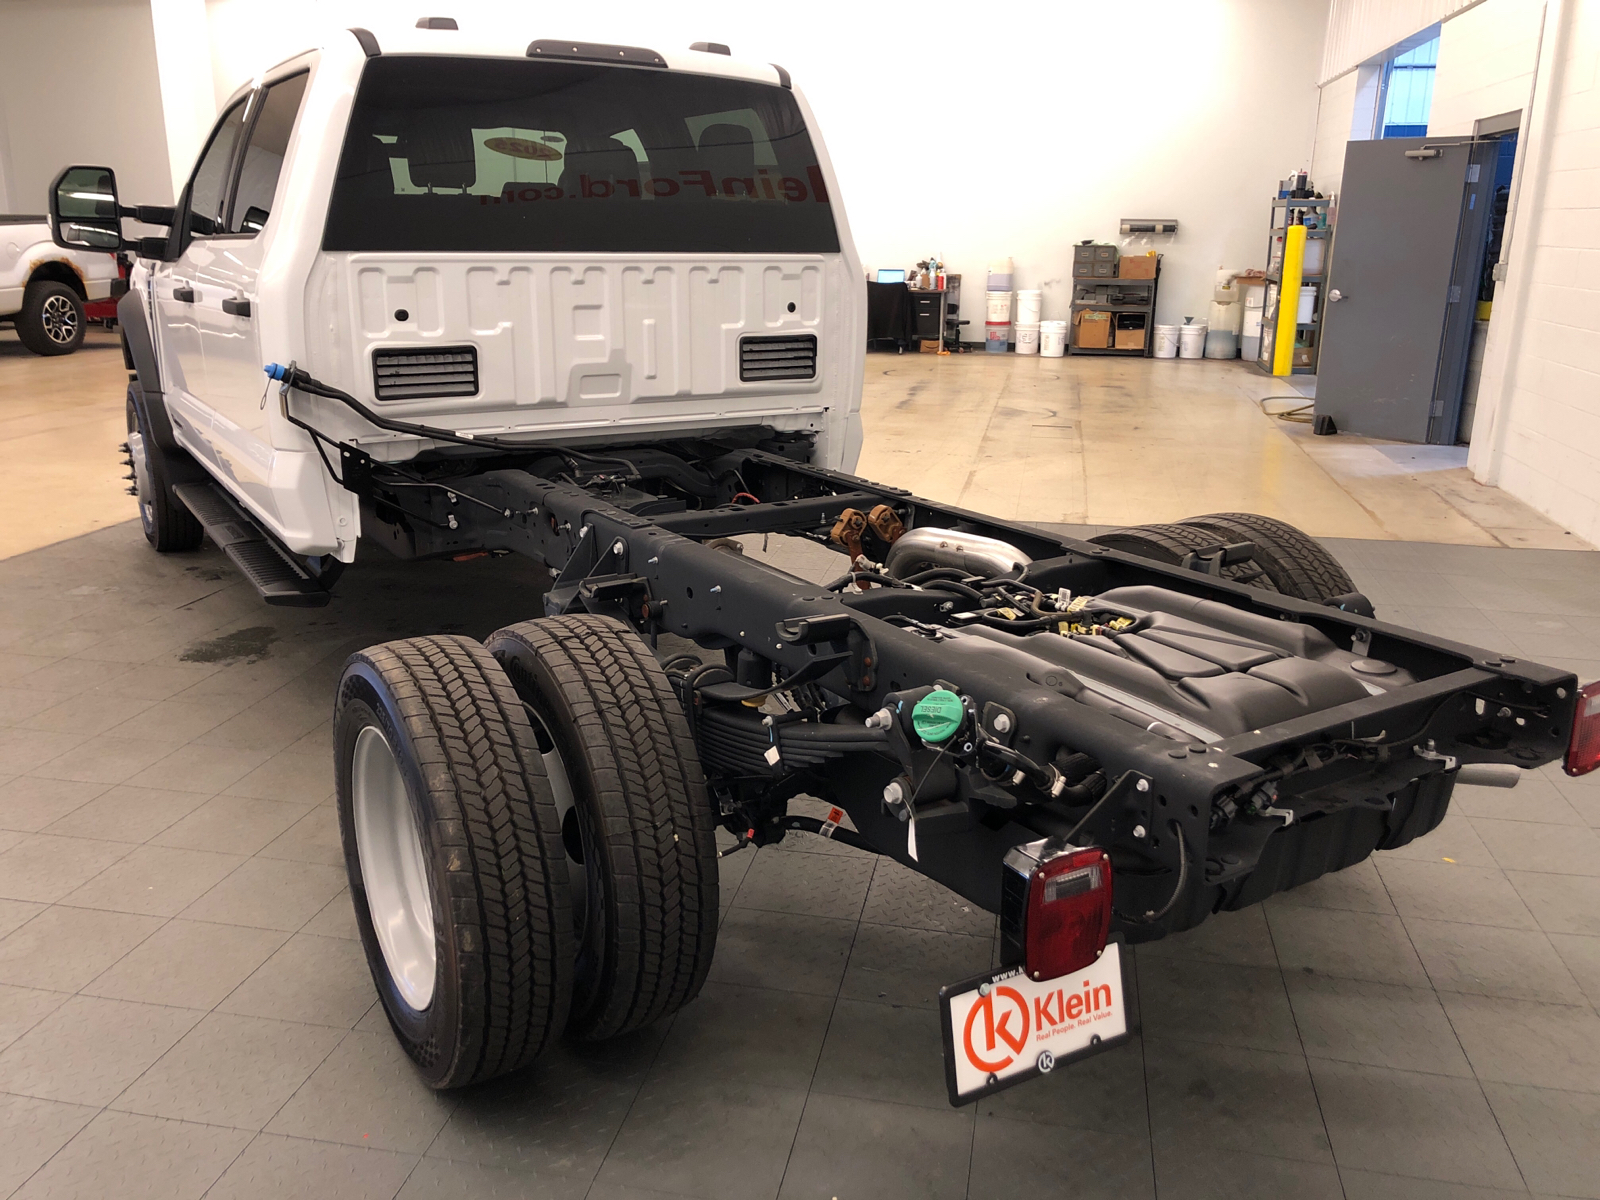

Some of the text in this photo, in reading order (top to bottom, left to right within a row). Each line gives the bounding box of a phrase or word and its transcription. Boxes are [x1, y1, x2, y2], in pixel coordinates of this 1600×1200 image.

[920, 705, 942, 714] DIESEL
[1034, 980, 1112, 1032] Klein
[1036, 1010, 1113, 1042] Real People. Real Value.
